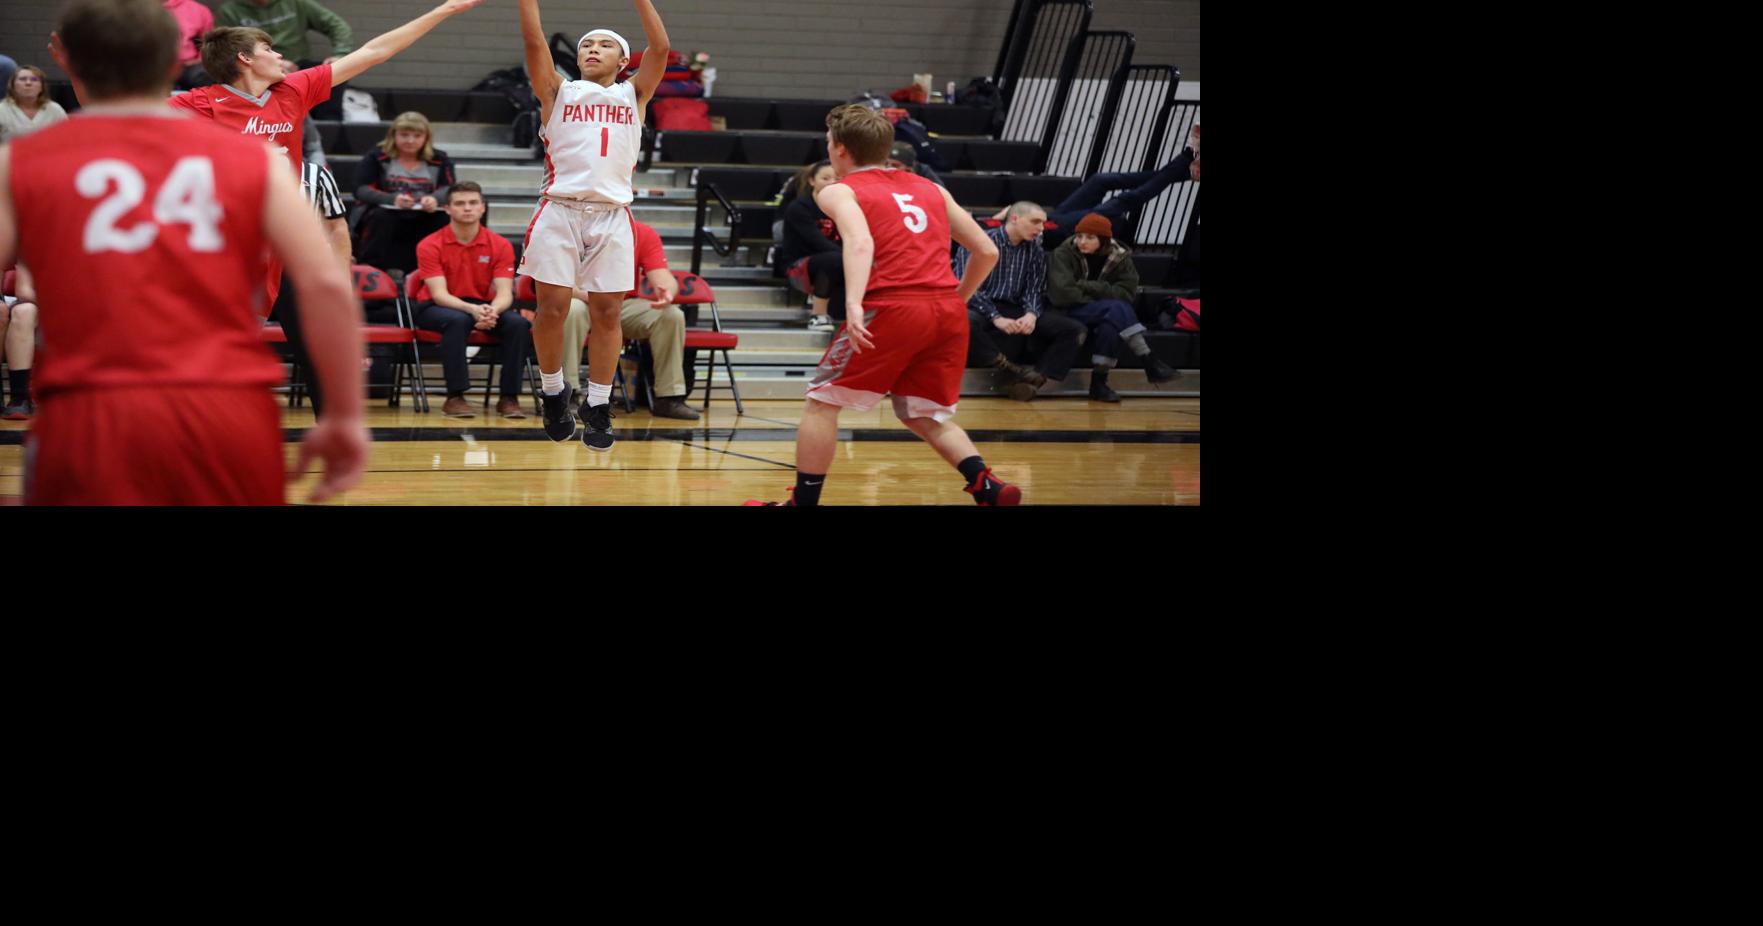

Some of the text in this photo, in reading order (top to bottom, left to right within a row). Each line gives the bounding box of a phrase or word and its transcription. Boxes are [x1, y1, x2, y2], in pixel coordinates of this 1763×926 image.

[241, 116, 293, 142] Mingus
[600, 127, 609, 157] 1
[75, 155, 225, 254] 24
[892, 192, 928, 233] 5
